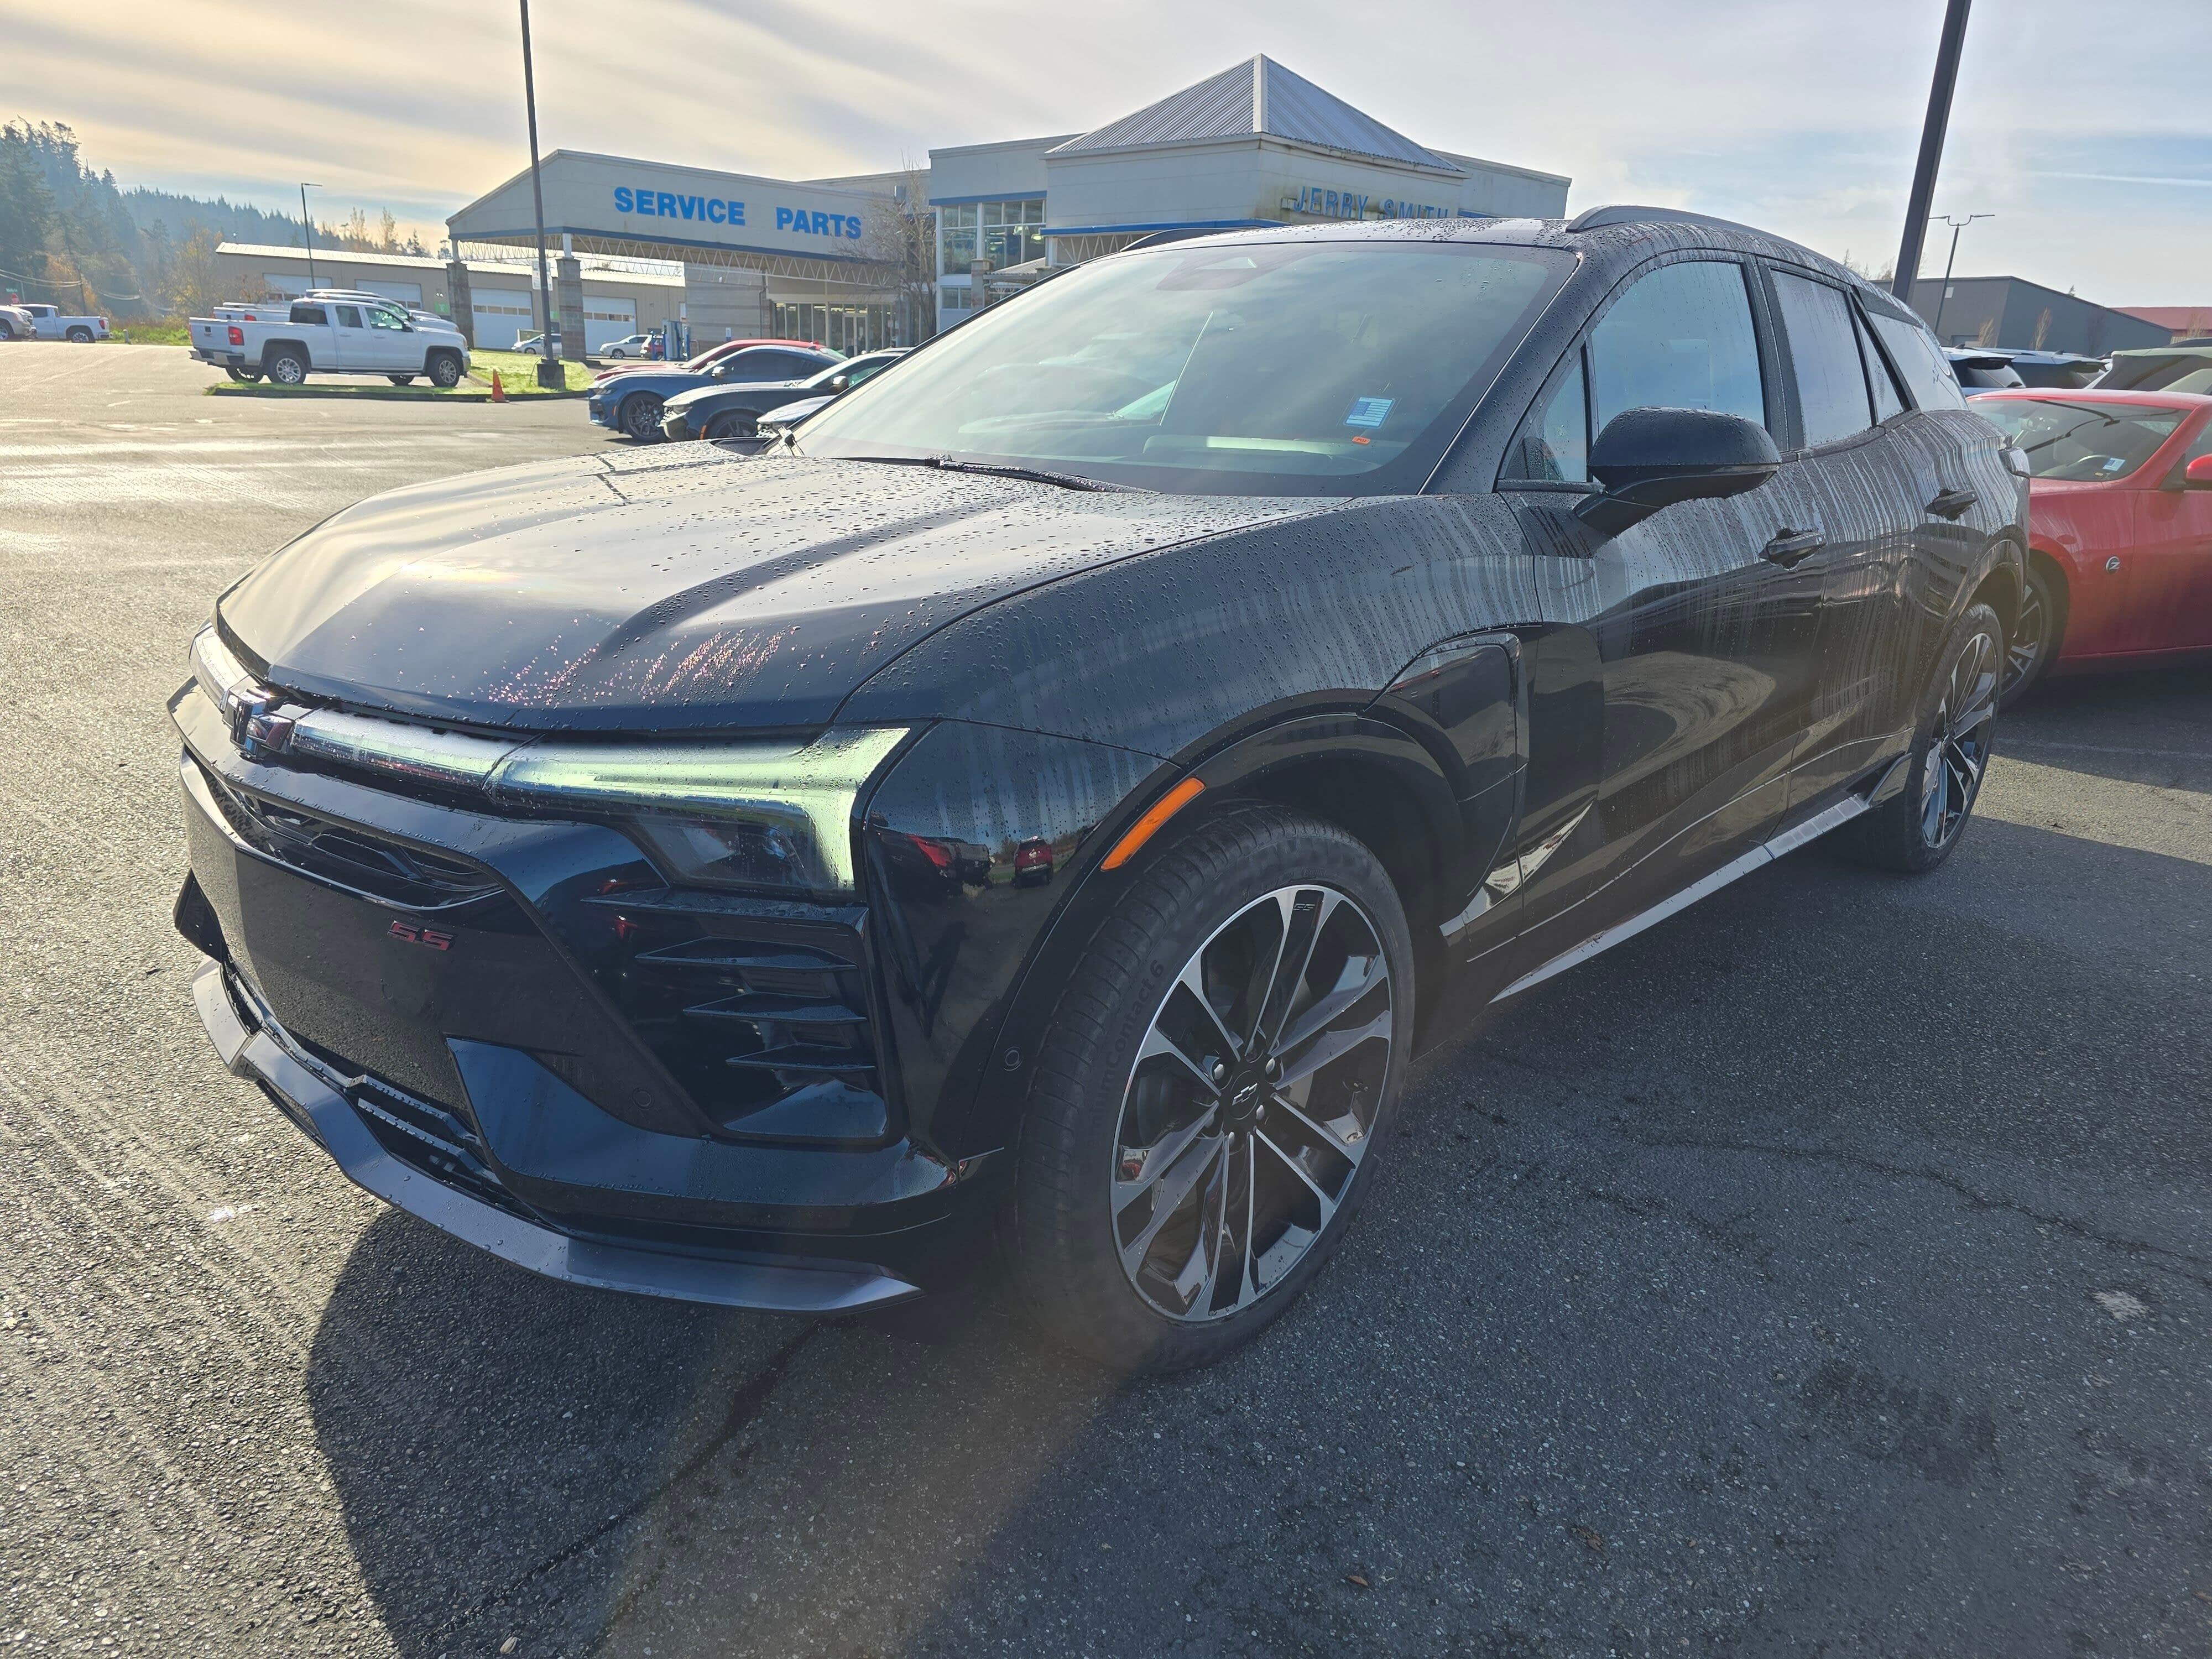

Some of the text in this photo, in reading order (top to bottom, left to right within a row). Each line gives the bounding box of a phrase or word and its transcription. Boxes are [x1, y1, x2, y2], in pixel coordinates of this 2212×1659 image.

[614, 186, 862, 239] SERVICE PARTS
[1293, 186, 1369, 220] JERRY
[388, 920, 454, 951] SS
[1150, 959, 1164, 978] 6
